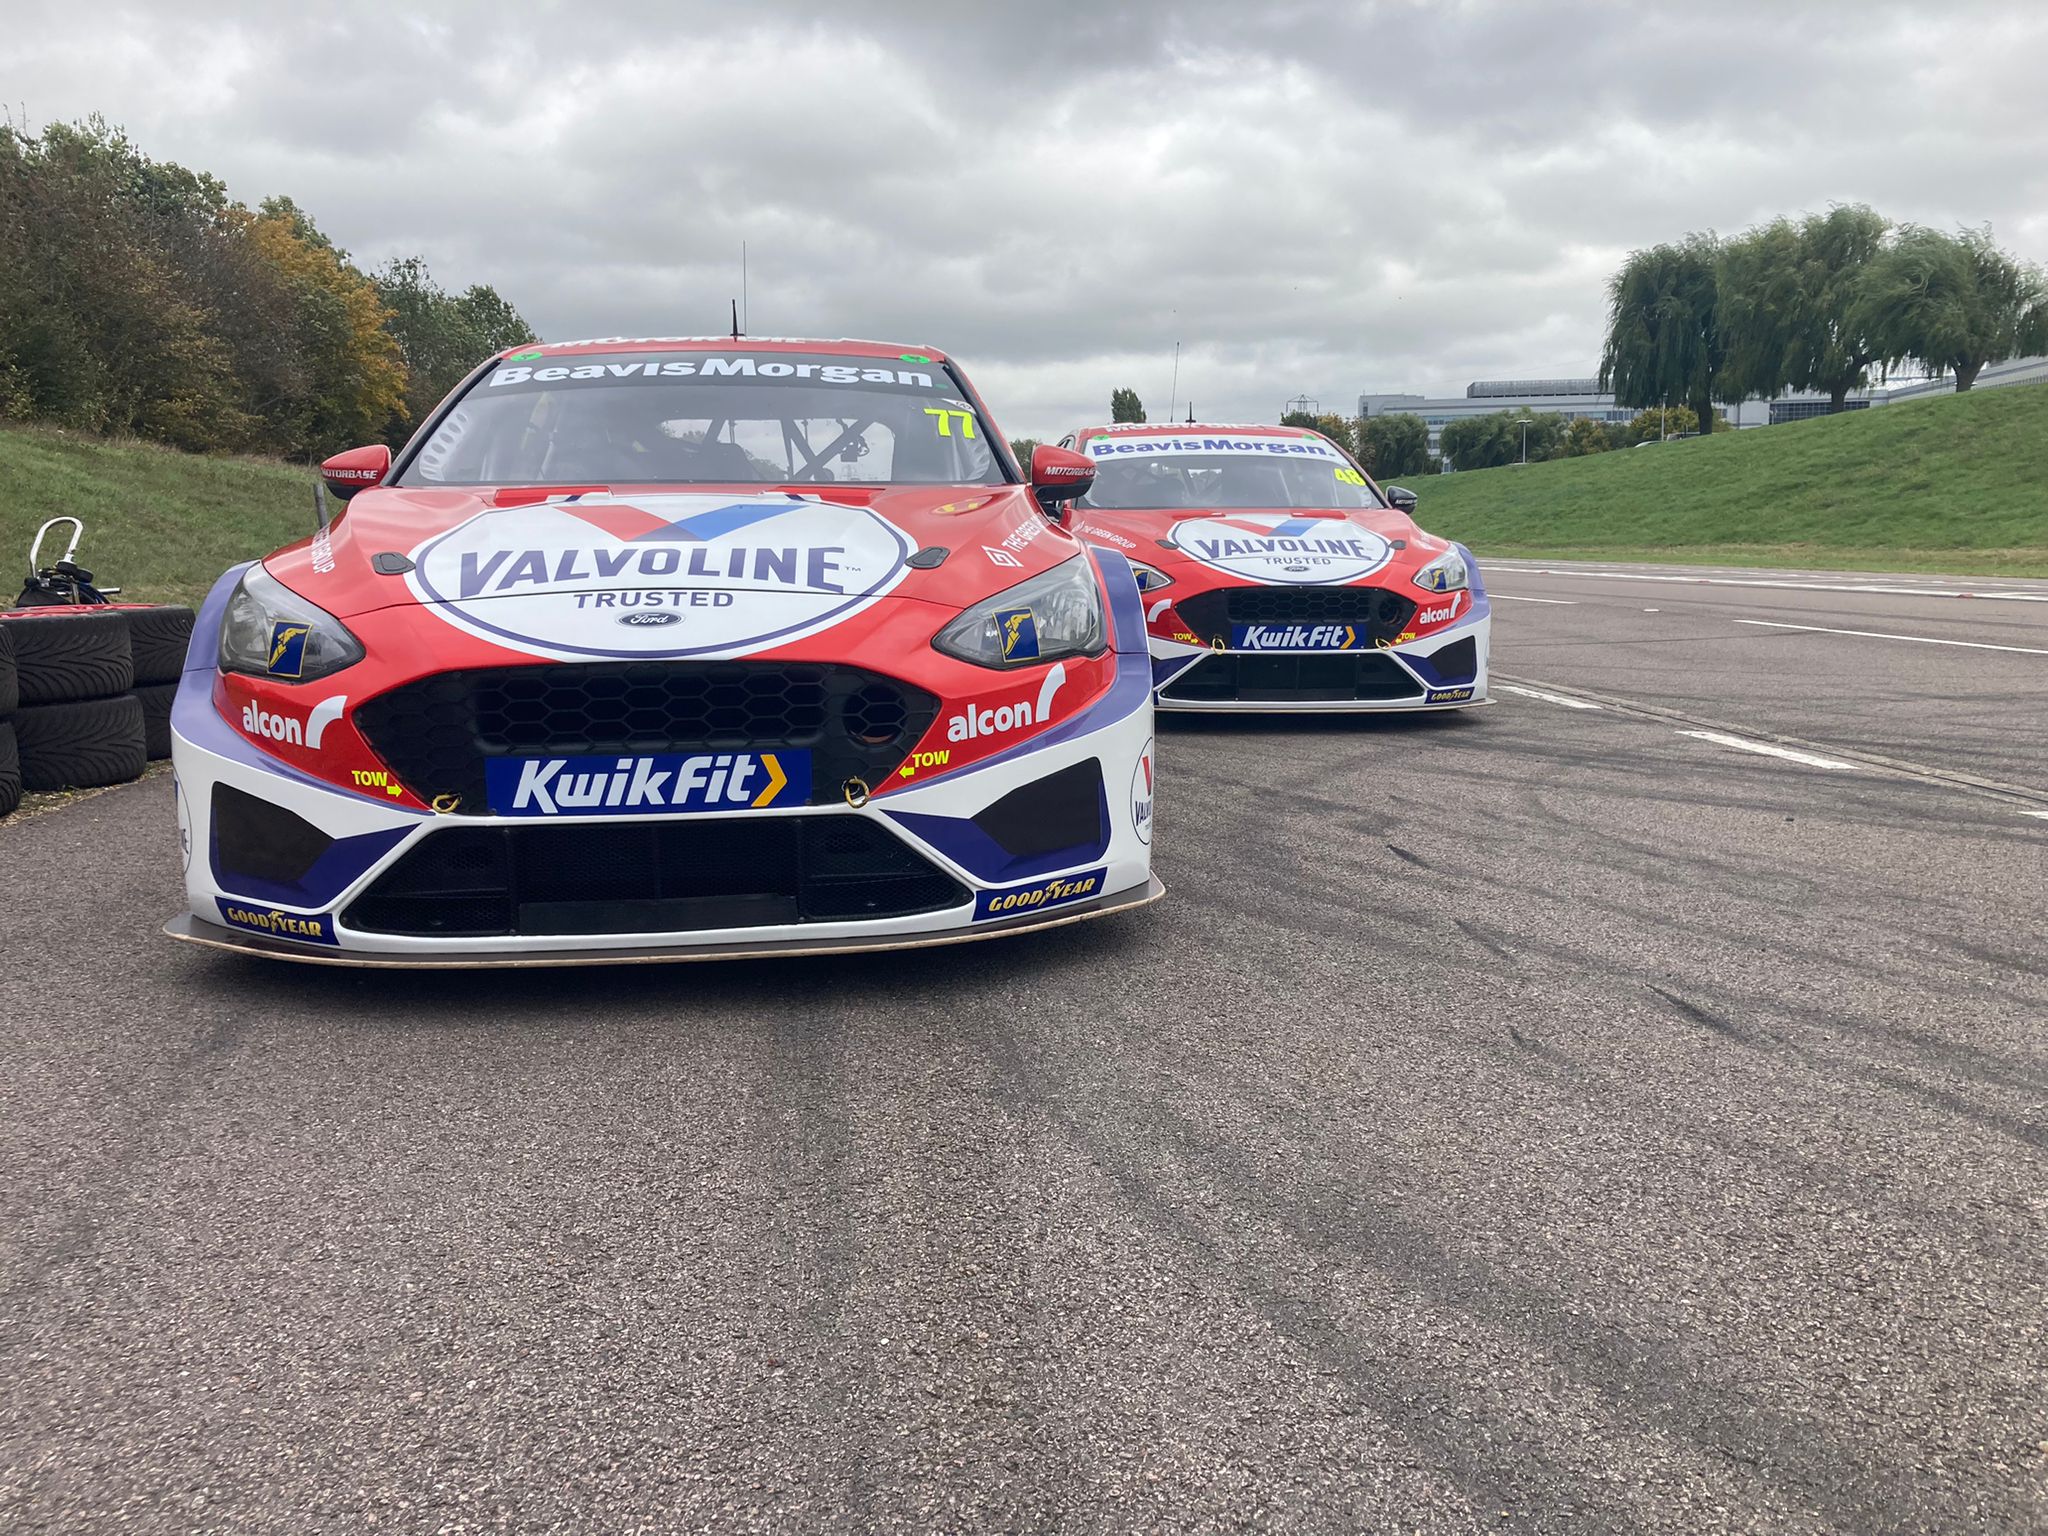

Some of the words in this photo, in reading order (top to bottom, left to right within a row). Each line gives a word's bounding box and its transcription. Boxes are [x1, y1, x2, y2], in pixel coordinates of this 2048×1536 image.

[924, 408, 976, 438] 77
[1334, 468, 1366, 487] 48
[1195, 539, 1372, 560] VALVOLINE
[1263, 557, 1331, 566] TRUSTED
[459, 547, 845, 598] VALVOLINE
[573, 591, 733, 608] TRUSTED
[630, 613, 669, 623] Ford
[1420, 607, 1449, 625] alcon
[243, 699, 302, 745] alcon
[948, 701, 1032, 742] alcon
[912, 750, 949, 768] TOW
[352, 770, 387, 786] TOW
